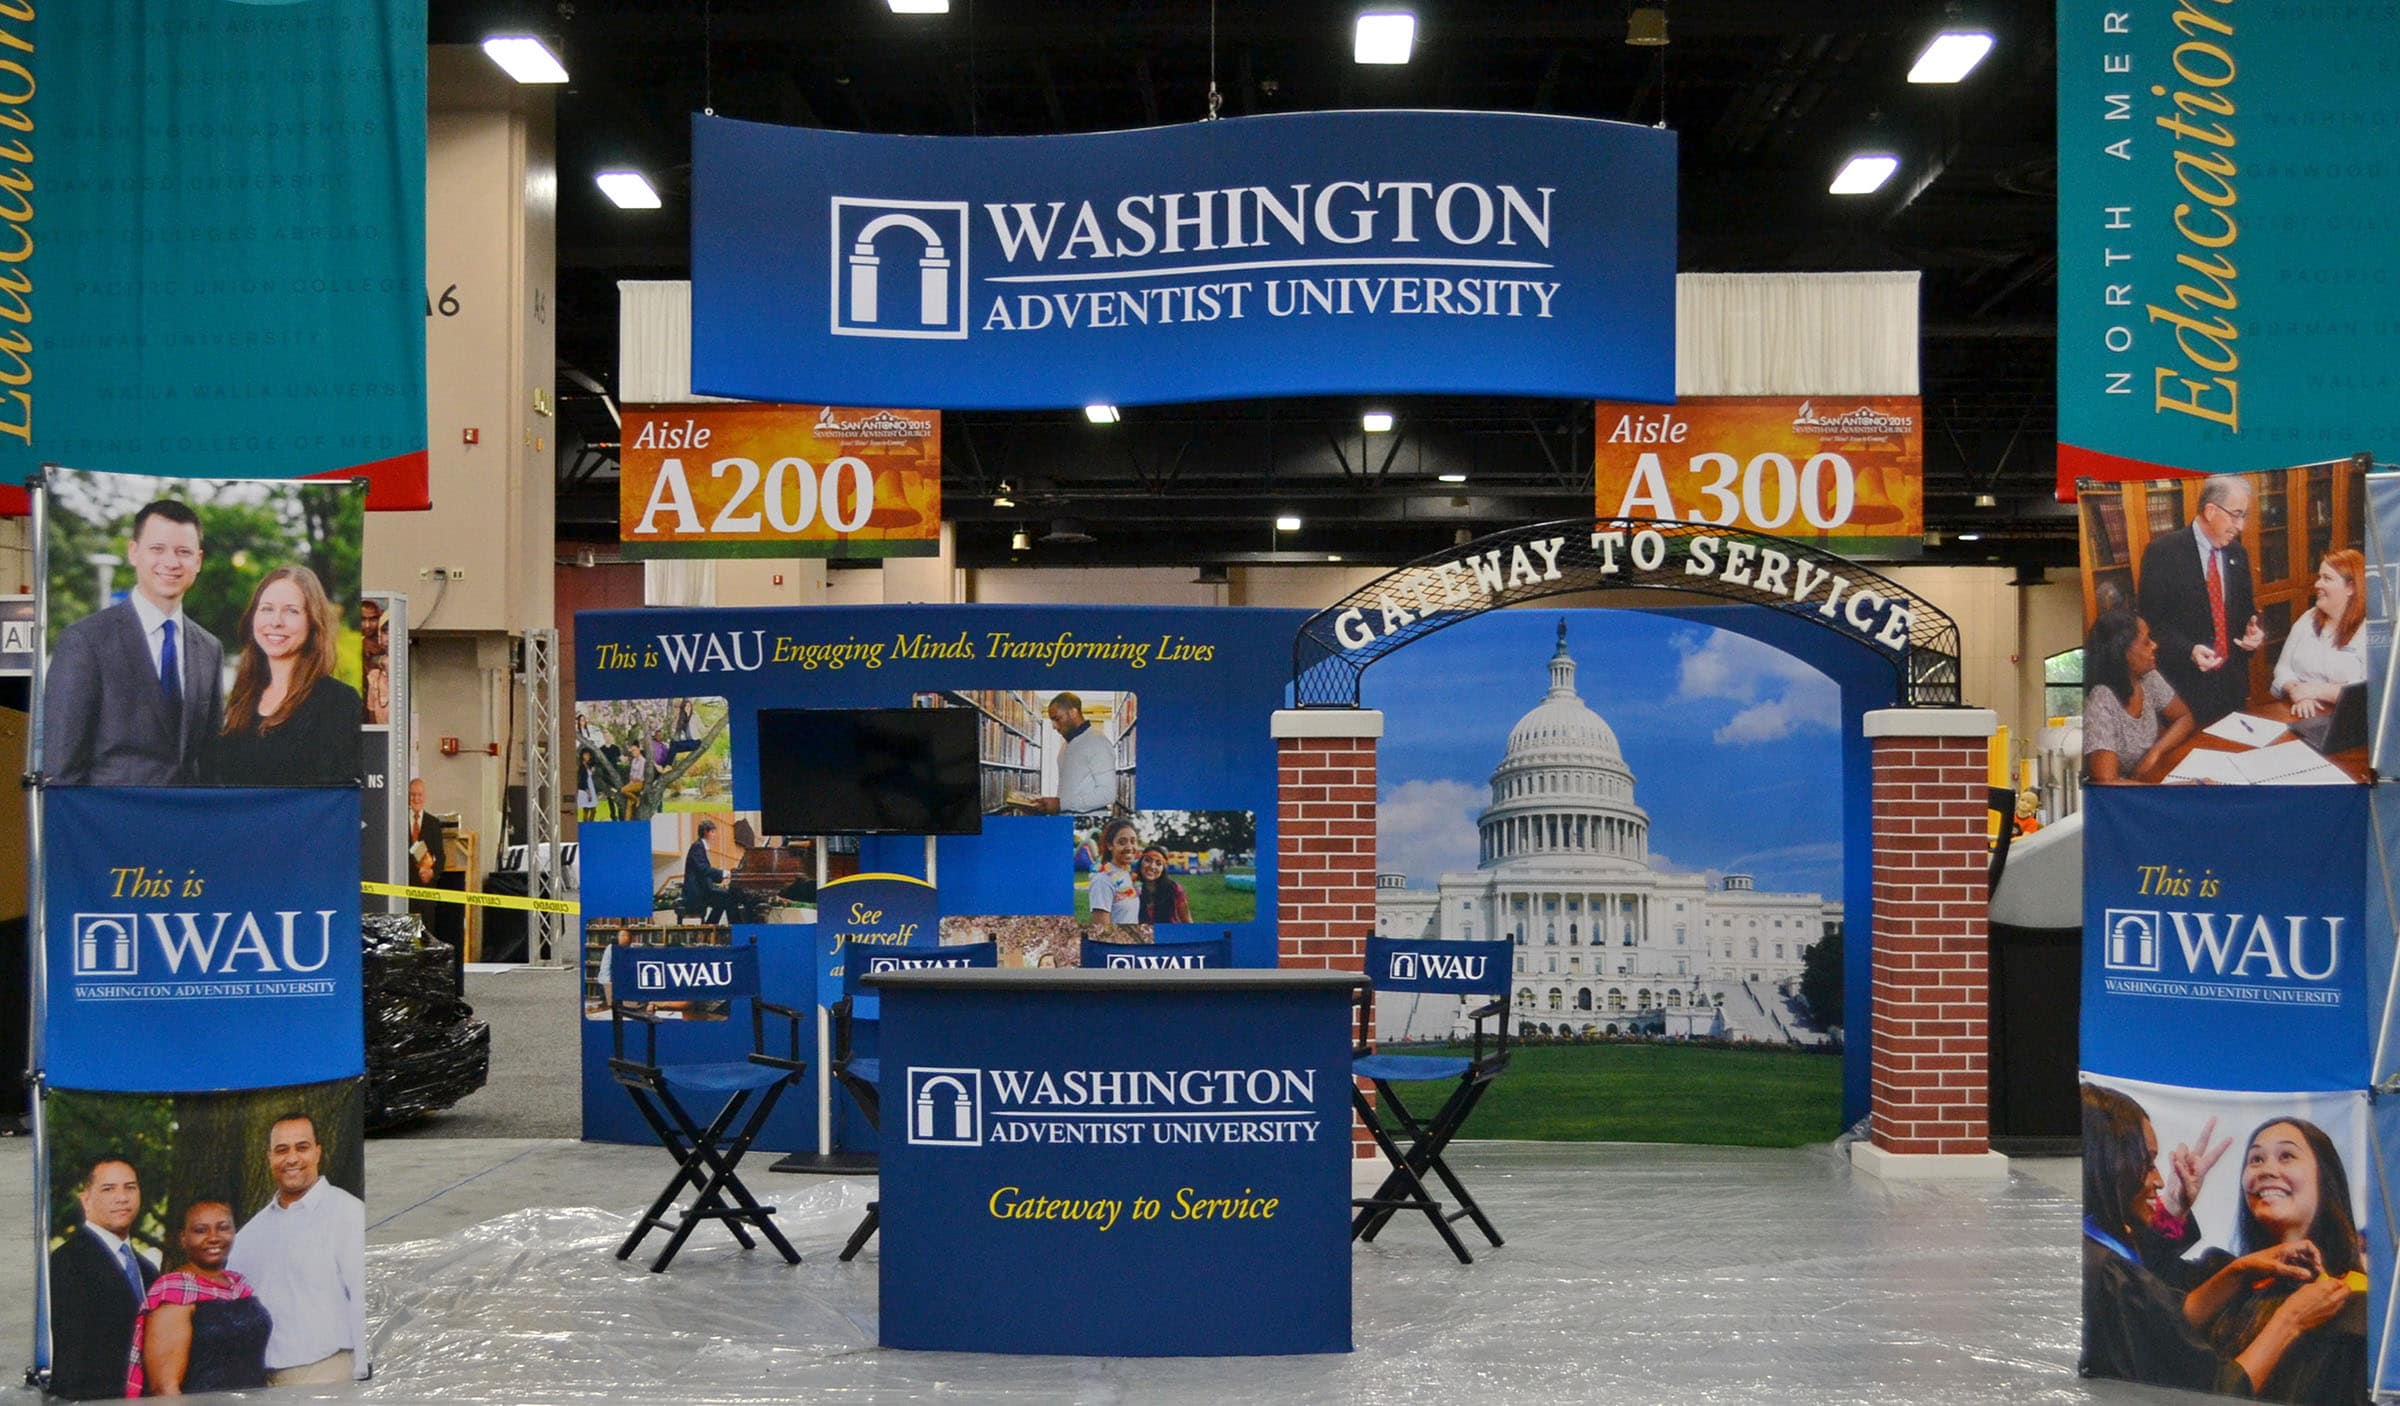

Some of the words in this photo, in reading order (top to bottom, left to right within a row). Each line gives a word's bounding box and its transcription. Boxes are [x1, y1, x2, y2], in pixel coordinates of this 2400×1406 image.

[2104, 13, 2131, 160] AMER
[984, 182, 1555, 262] WASHINGTON
[427, 284, 459, 316] 6
[983, 282, 1252, 330] ADVENTIST
[1265, 278, 1560, 317] UNIVERSITY
[2105, 207, 2132, 393] NORTH
[633, 420, 710, 450] Aisle
[908, 421, 931, 430] 2015
[1608, 414, 1687, 447] Aisle
[1889, 416, 1912, 426] 2015
[634, 457, 874, 535] A200
[1609, 453, 1854, 529] A300
[1335, 537, 1565, 650] GATEWAY
[1591, 530, 1666, 574] TO
[1685, 536, 1917, 652] SERVICE
[597, 643, 637, 669] This
[644, 644, 658, 667] is
[657, 631, 765, 673] WAU
[772, 636, 885, 669] Engaging
[890, 632, 975, 659] Minds,
[987, 632, 1151, 668] Transforming
[1156, 635, 1214, 661] Lives
[111, 867, 173, 897] This
[182, 870, 204, 897] is
[2138, 865, 2191, 896] This
[2200, 869, 2219, 897] is
[848, 903, 882, 924] See
[146, 910, 336, 973] WAU
[829, 924, 919, 955] yurself
[2167, 912, 2344, 980] WAU
[667, 962, 732, 986] WAU
[1420, 955, 1487, 980] WAU
[75, 983, 171, 998] WASHINGTON
[175, 981, 252, 996] ADVENTIST
[255, 980, 336, 995] UNIVERSITY
[2104, 979, 2188, 996] WASHINGTON
[2191, 984, 2261, 1001] ADVENTIST
[2263, 989, 2341, 1004] UNIVERSITY
[989, 1070, 1316, 1105] WASHINGTON
[990, 1122, 1145, 1143] ADVENTIST
[1153, 1122, 1320, 1143] UNIVERSITY
[990, 1187, 1122, 1231] Gateway
[1133, 1197, 1160, 1219] to
[1171, 1188, 1278, 1219] Service
